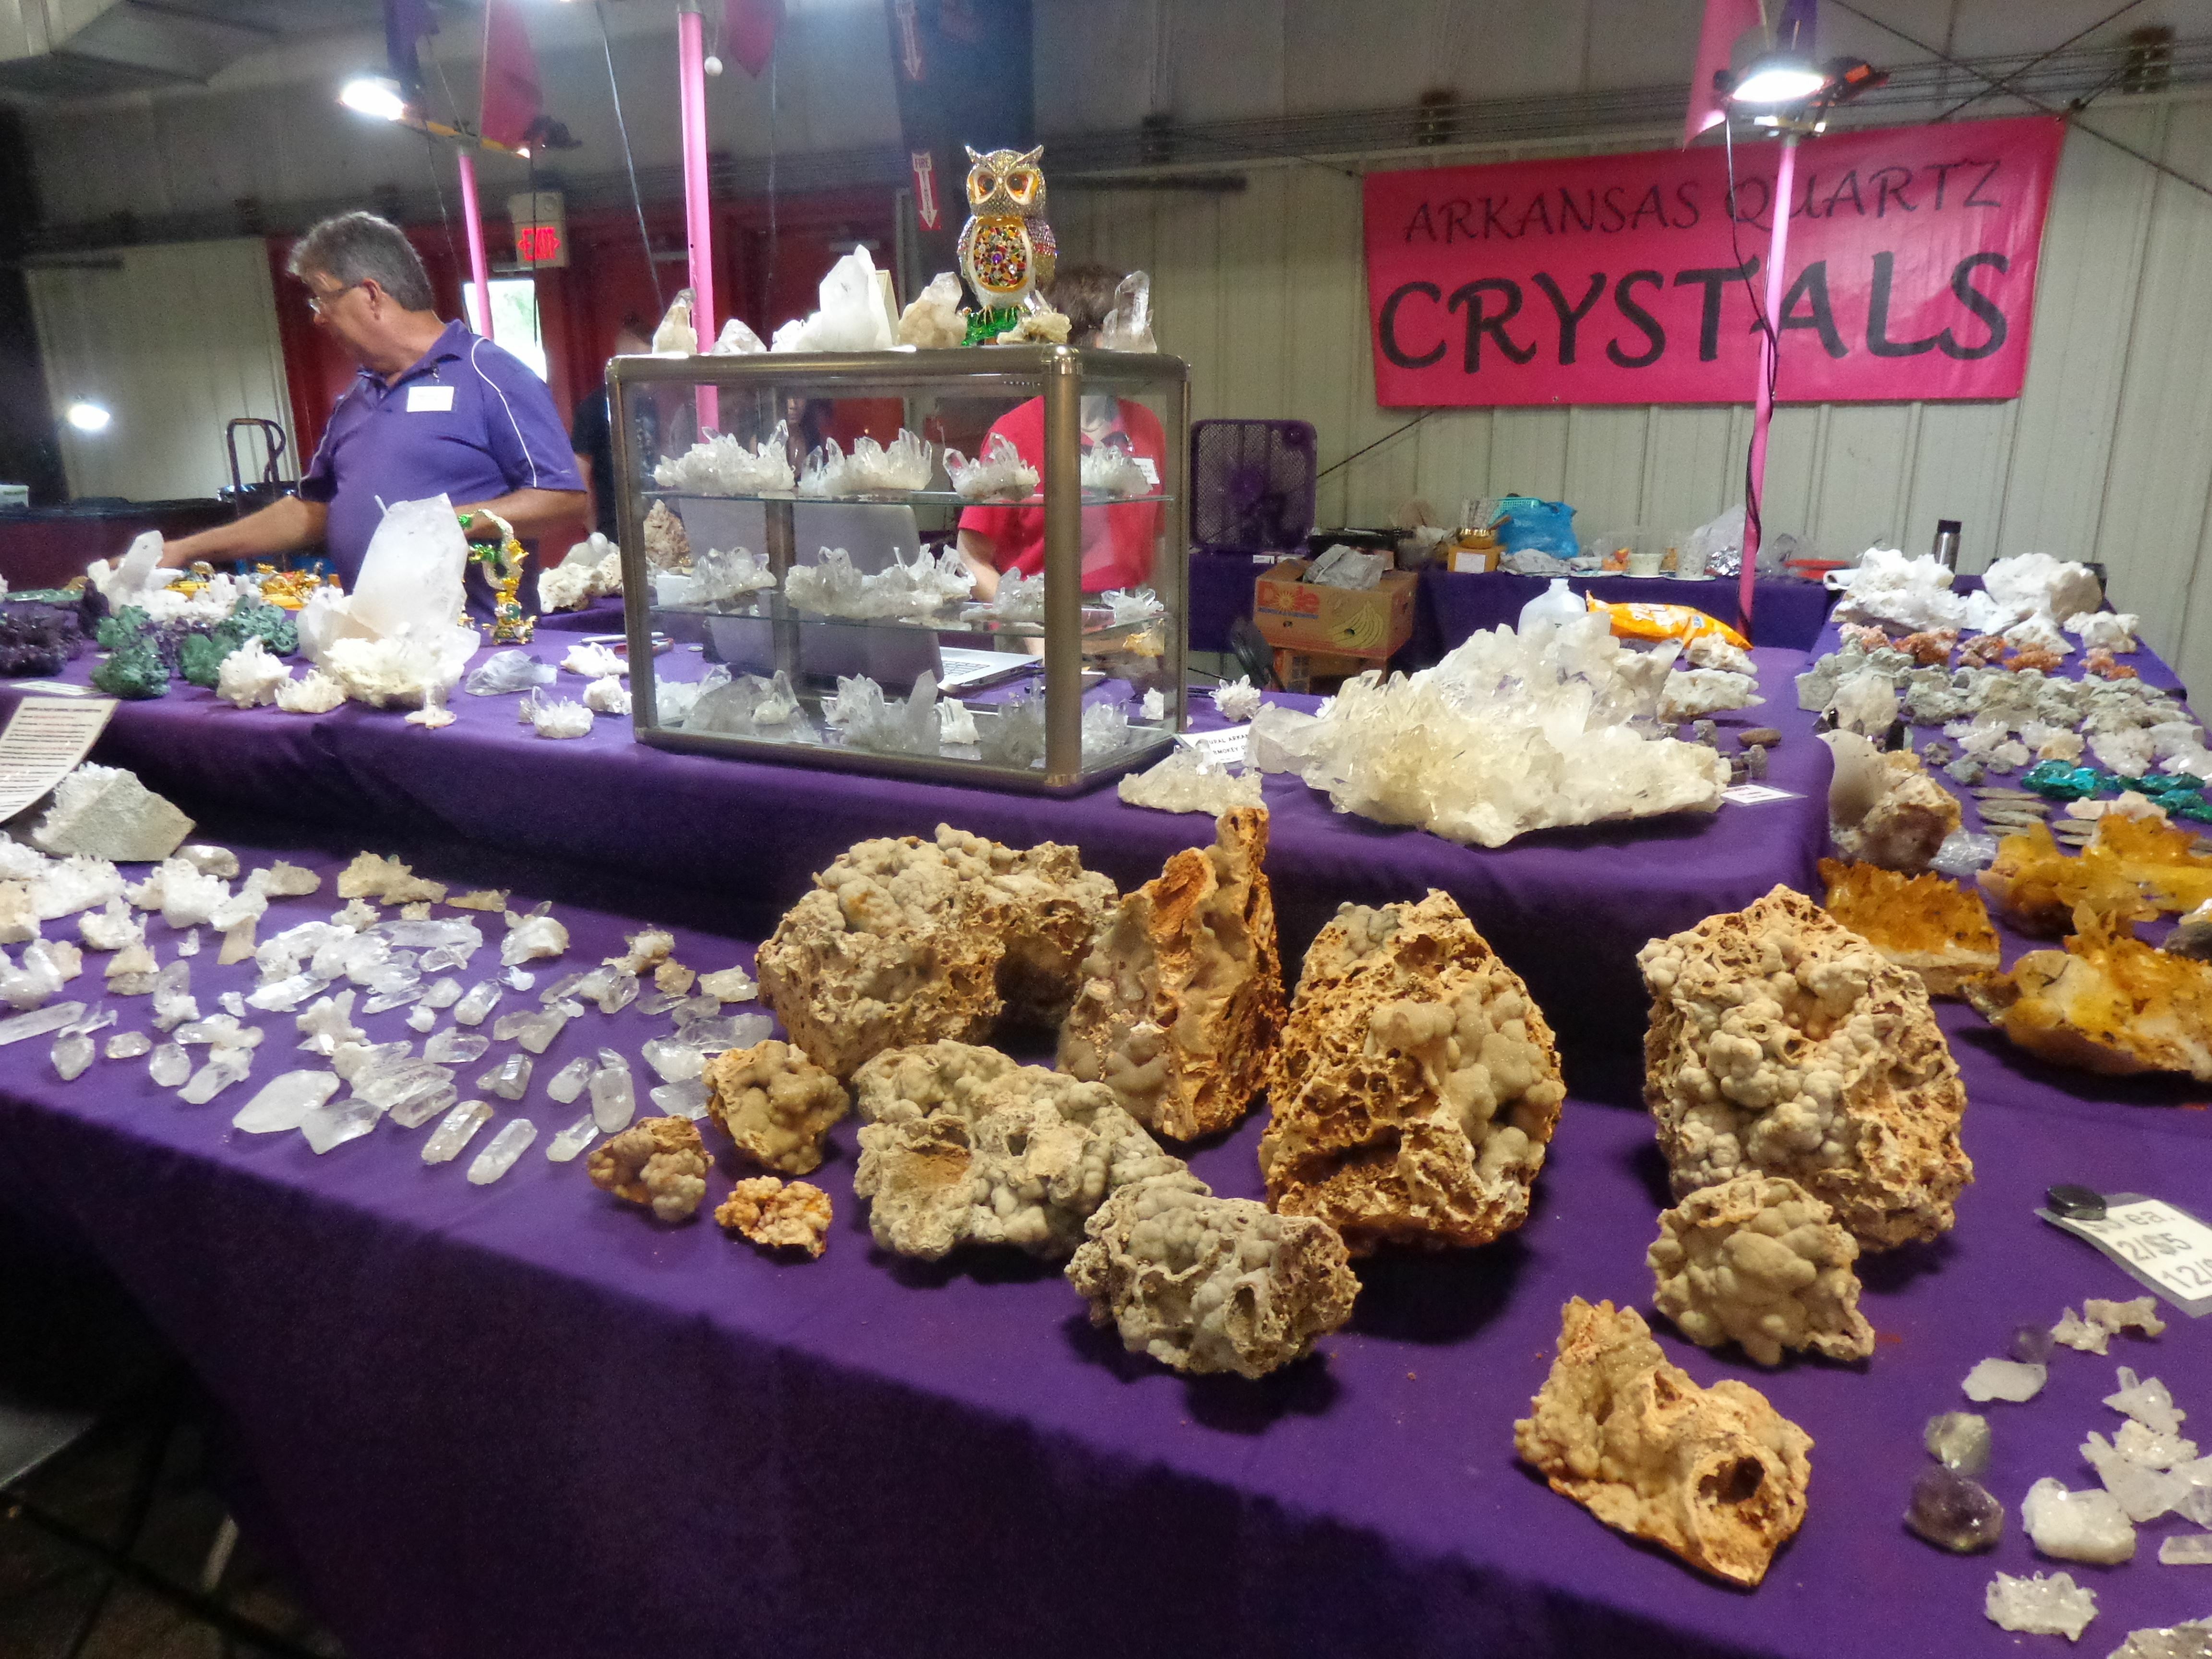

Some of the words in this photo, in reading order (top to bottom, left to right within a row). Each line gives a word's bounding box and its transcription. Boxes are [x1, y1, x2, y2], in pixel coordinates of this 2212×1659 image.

[914, 157, 930, 168] FIRE
[1404, 181, 1701, 244] ARKANSAS
[1723, 158, 2002, 231] QUARTZ
[1378, 251, 2008, 373] CRYSTALS
[1213, 746, 1238, 755] SMOKEY
[2161, 1258, 2212, 1288] 12/
